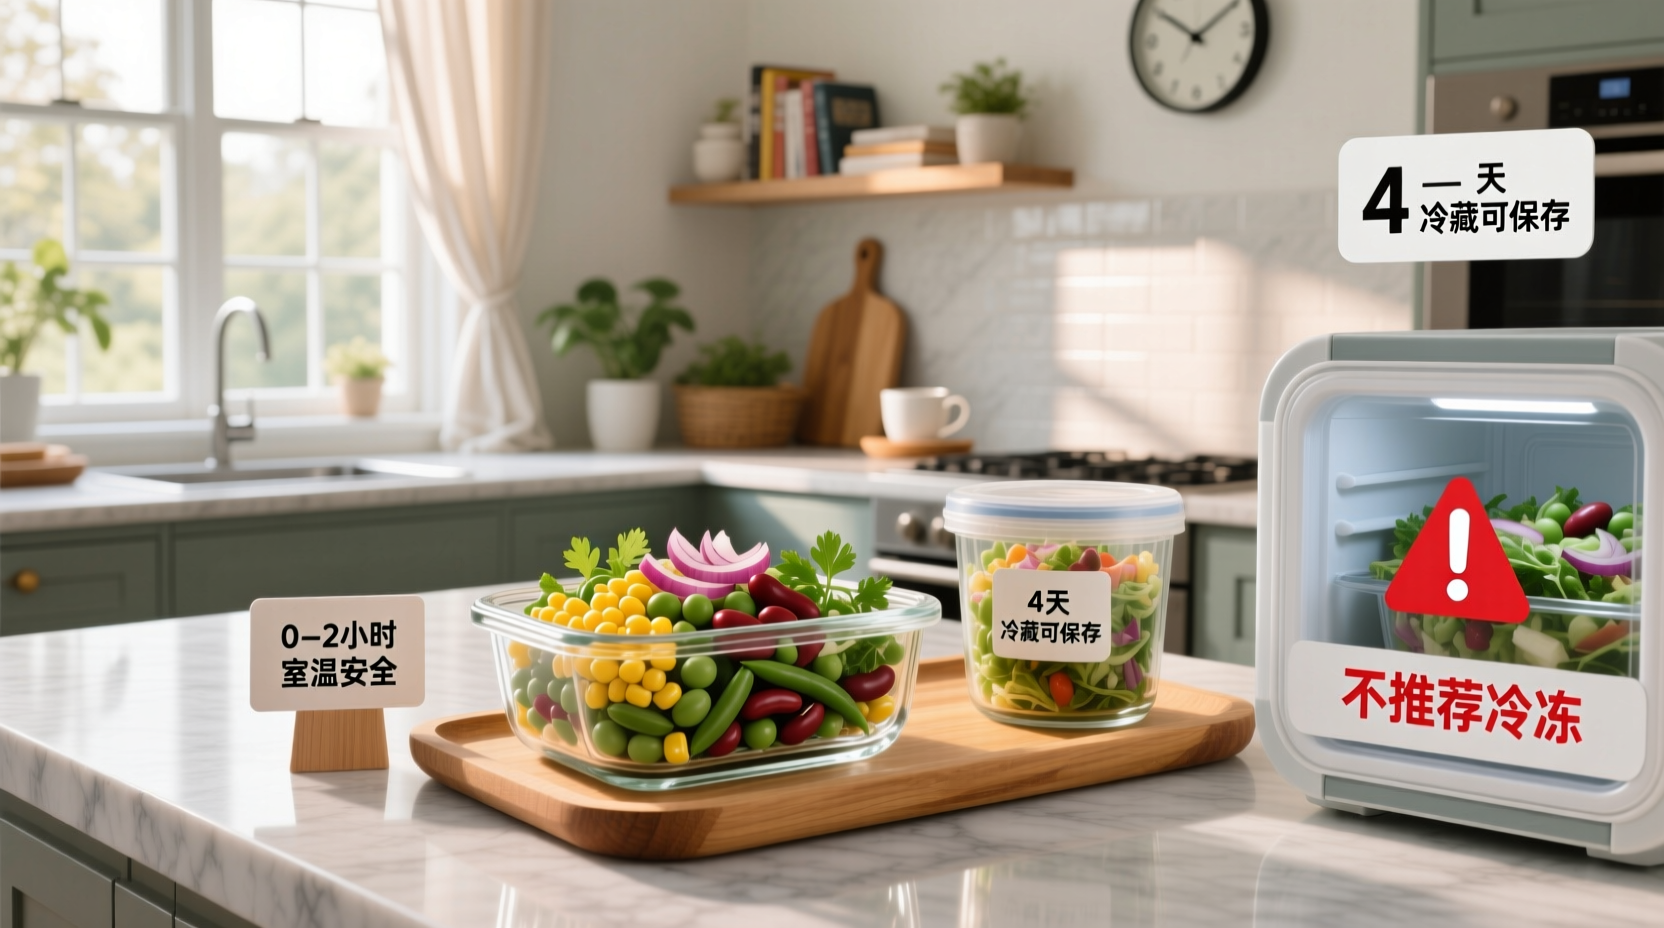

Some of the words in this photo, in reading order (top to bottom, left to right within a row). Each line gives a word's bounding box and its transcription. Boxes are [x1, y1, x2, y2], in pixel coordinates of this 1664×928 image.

[1362, 166, 1409, 234] 4
[1476, 162, 1507, 195] 天
[1419, 198, 1570, 234] 冷藏可保存
[1027, 589, 1070, 616] 4天
[1000, 619, 1102, 645] 冷藏可保存
[281, 655, 398, 689] 室温安全
[1341, 667, 1583, 744] 不推荐冷冻
